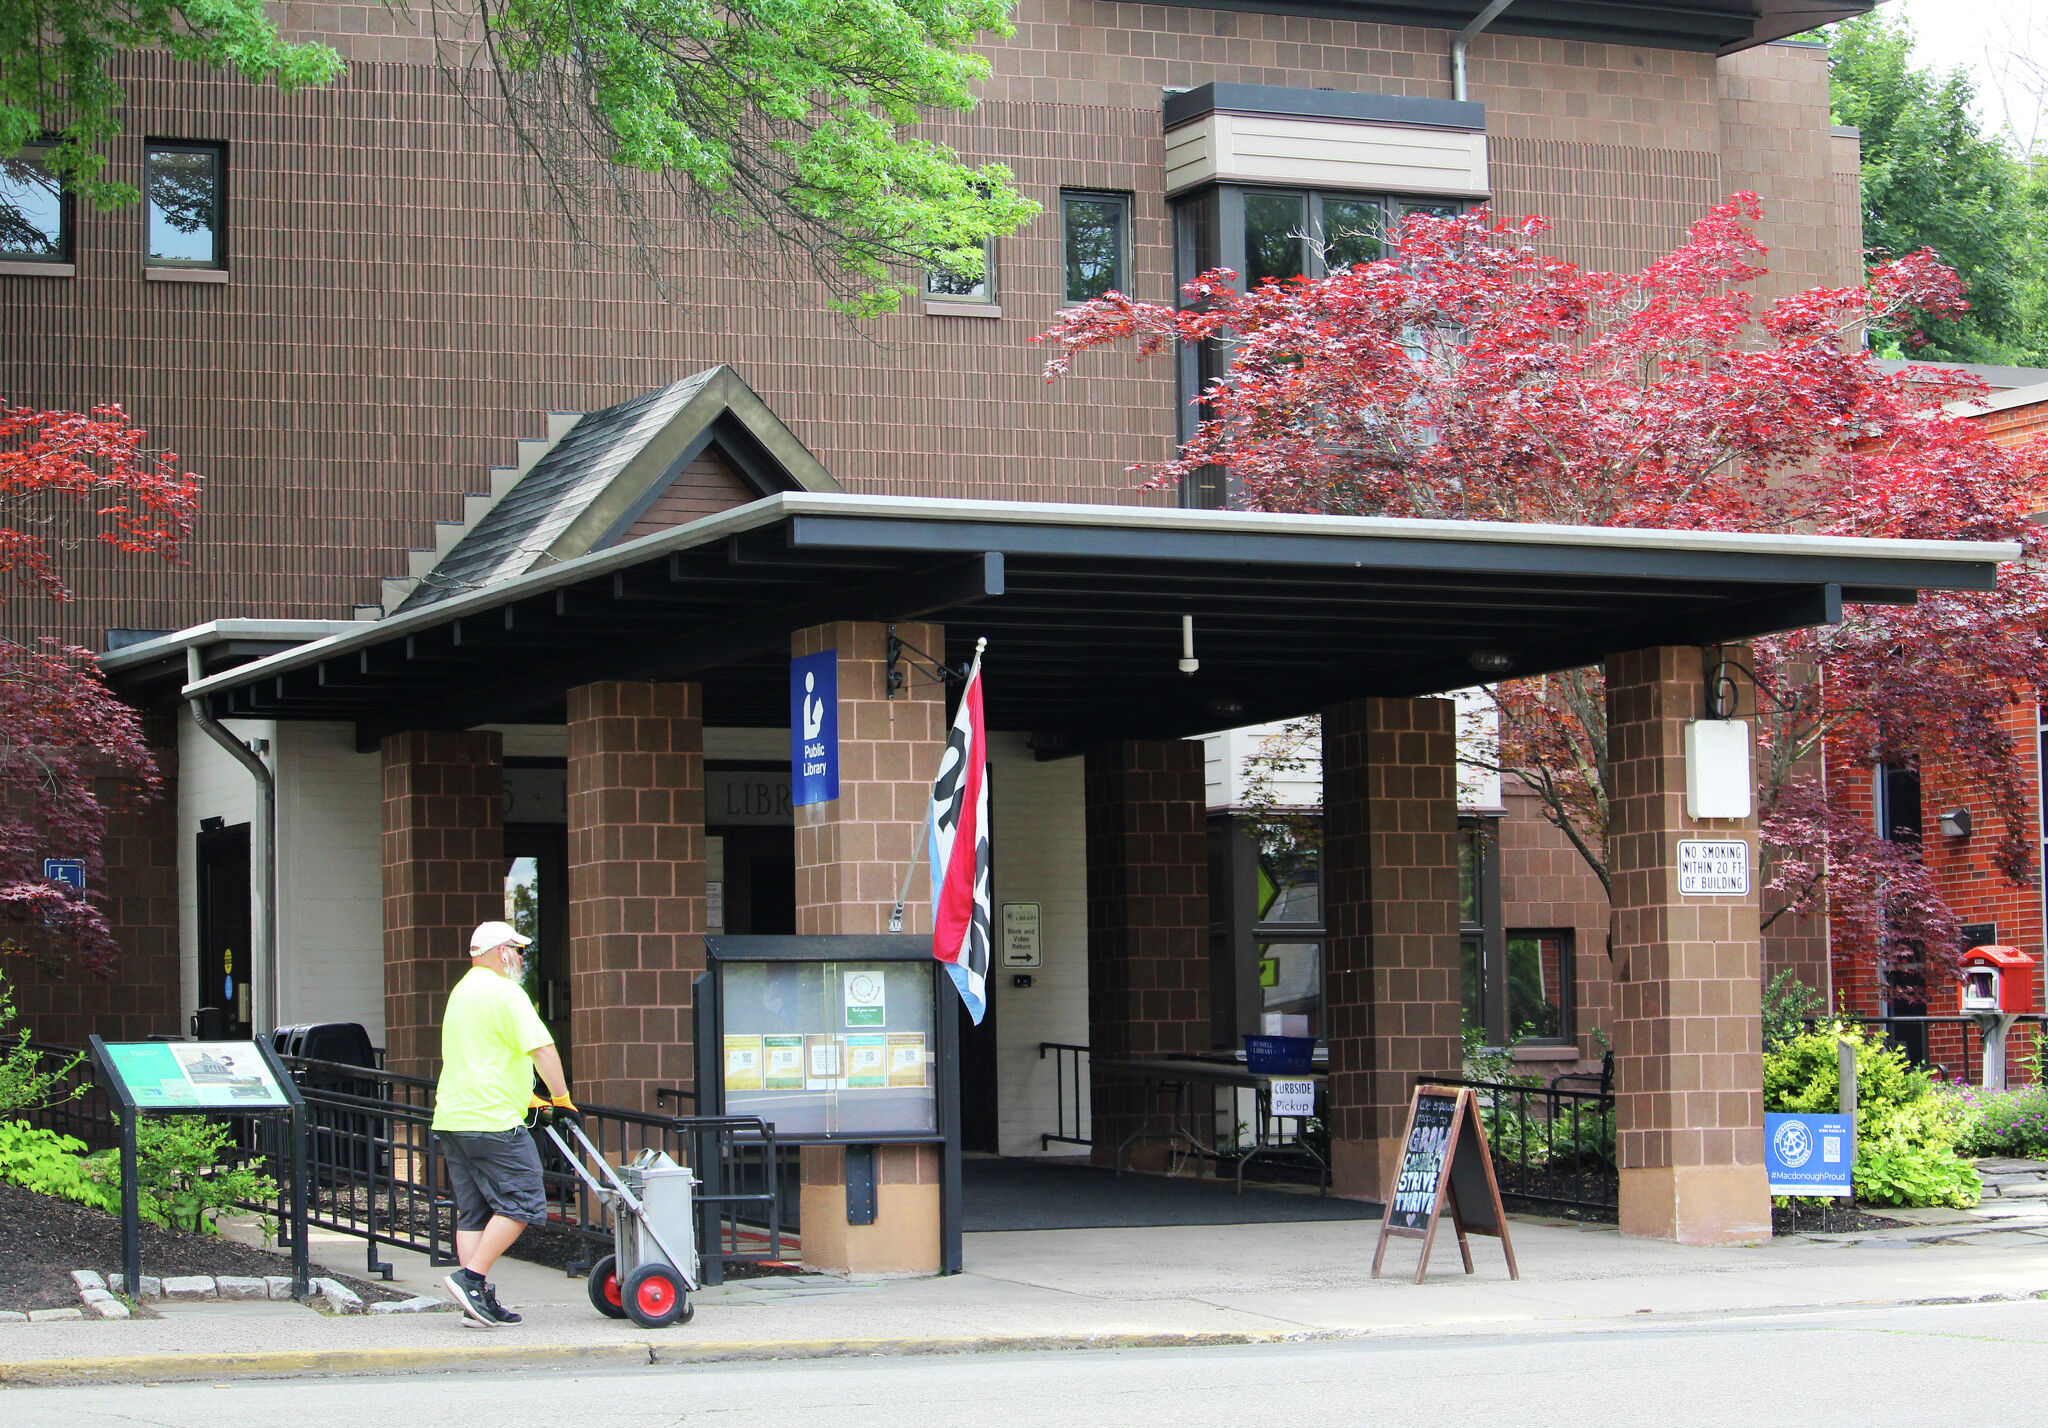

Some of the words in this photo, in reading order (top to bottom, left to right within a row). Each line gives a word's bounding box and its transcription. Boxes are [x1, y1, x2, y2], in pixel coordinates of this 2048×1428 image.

[805, 743, 825, 760] Public
[803, 761, 827, 777] Library
[1685, 846, 1697, 858] NO
[1702, 846, 1741, 859] SMOKING
[1682, 861, 1712, 873] WITHIN
[1717, 861, 1728, 874] 20
[1685, 876, 1695, 889] OF
[1701, 876, 1743, 889] BUILDING
[1274, 1083, 1312, 1095] CURBSIDE
[1276, 1099, 1309, 1113] Pickup
[1398, 1171, 1438, 1193] STRIVE
[1771, 1172, 1846, 1181] #MacdonoughProud
[1395, 1192, 1437, 1215] THRIVE
